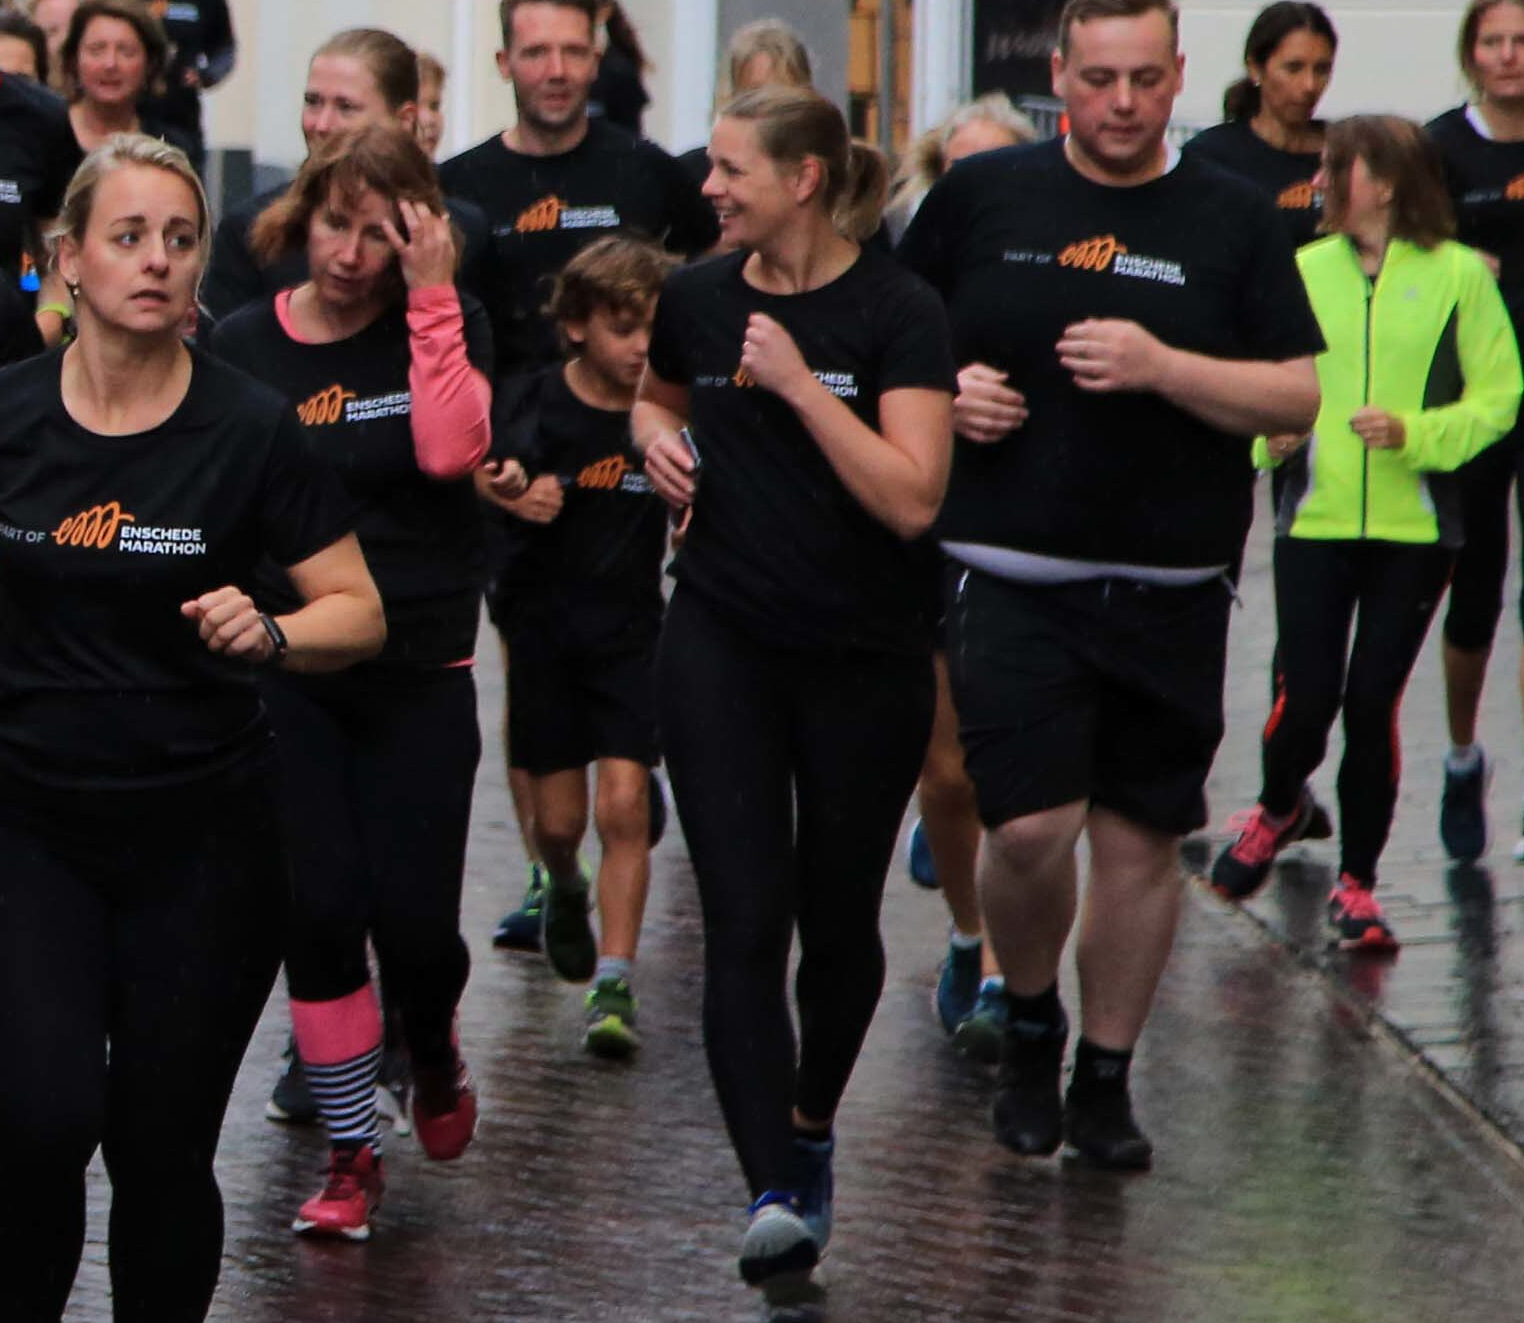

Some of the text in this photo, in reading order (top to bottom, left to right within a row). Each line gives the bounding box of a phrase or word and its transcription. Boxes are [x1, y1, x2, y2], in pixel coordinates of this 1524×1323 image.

[346, 404, 411, 422] MARATHO
[25, 531, 46, 543] OF
[121, 525, 201, 541] ENSCHEDE
[119, 540, 206, 555] MARATHON
